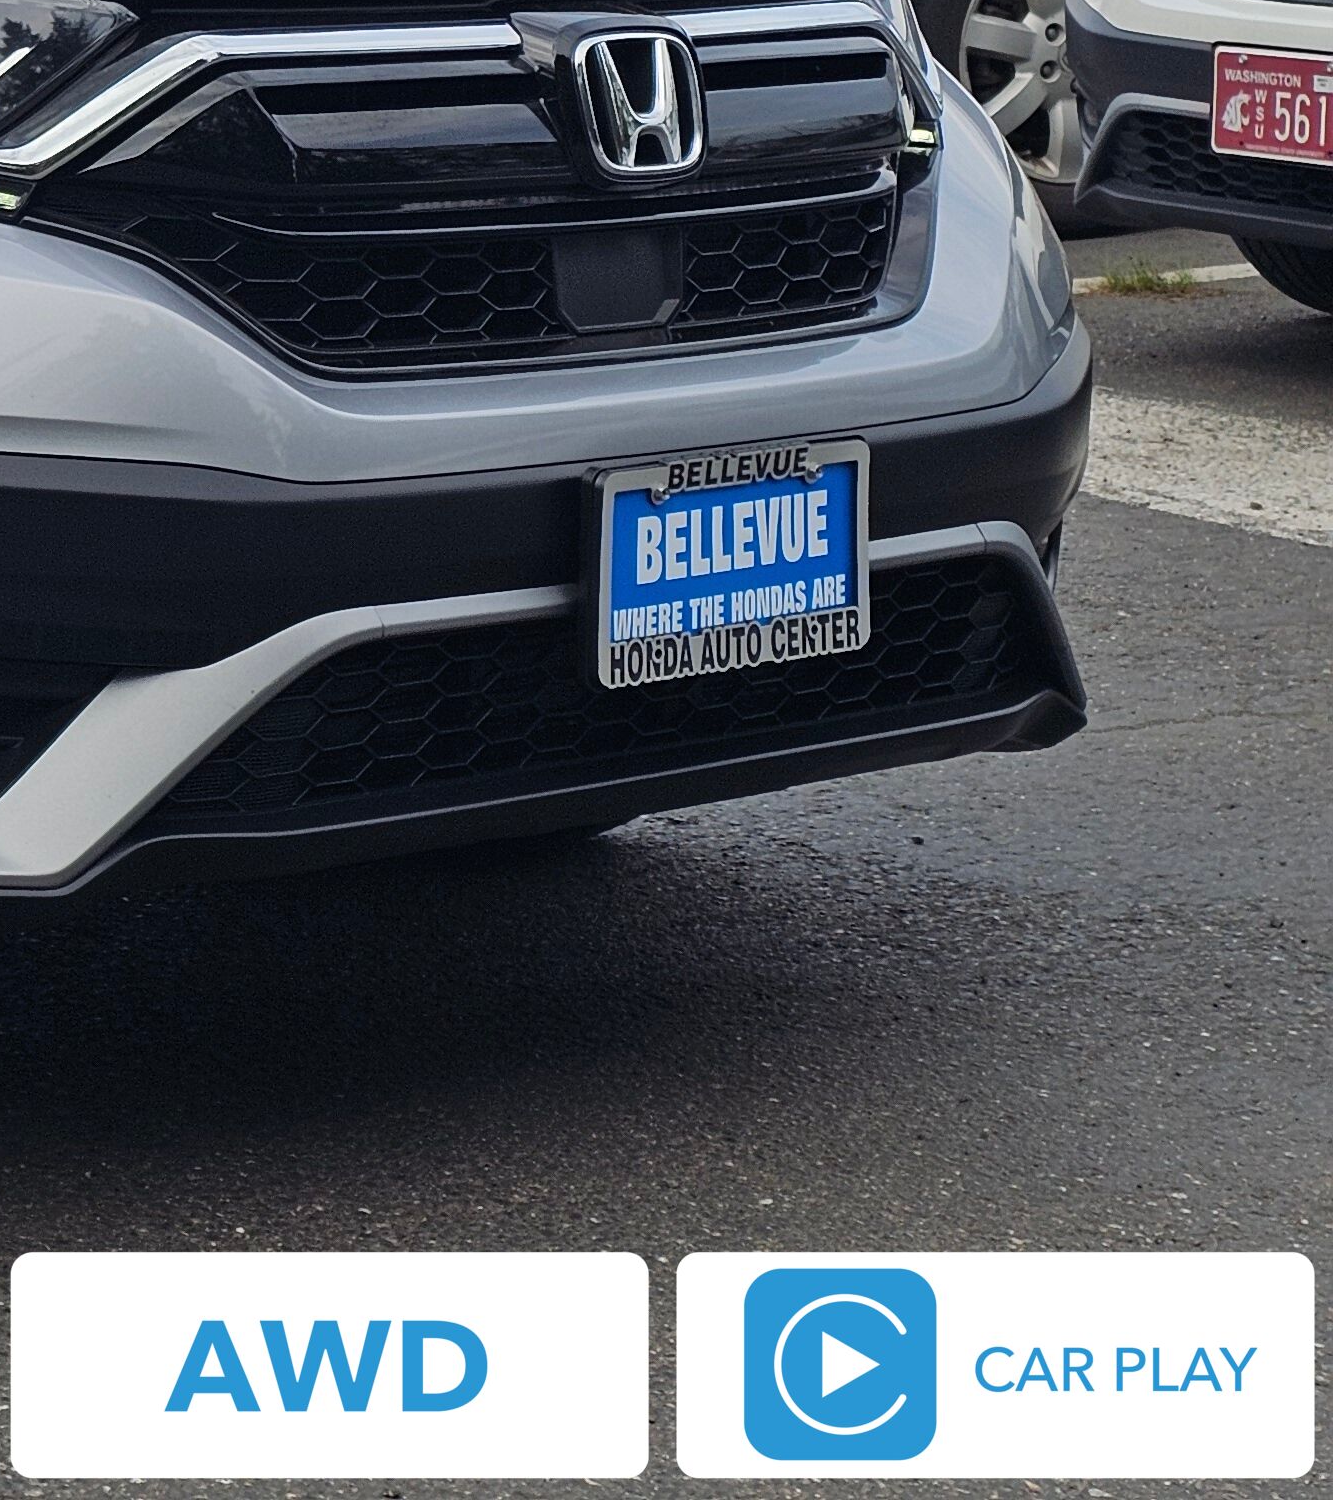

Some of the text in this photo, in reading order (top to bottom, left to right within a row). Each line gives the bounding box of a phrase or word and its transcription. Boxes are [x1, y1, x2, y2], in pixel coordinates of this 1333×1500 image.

[1224, 69, 1301, 88] WASHINGTON
[668, 446, 810, 492] BELLEVUE
[636, 489, 830, 586] BELLEVUE
[613, 574, 846, 642] WHERE THE HONDAS ARE
[610, 609, 861, 686] HONDA AUTO CENTER
